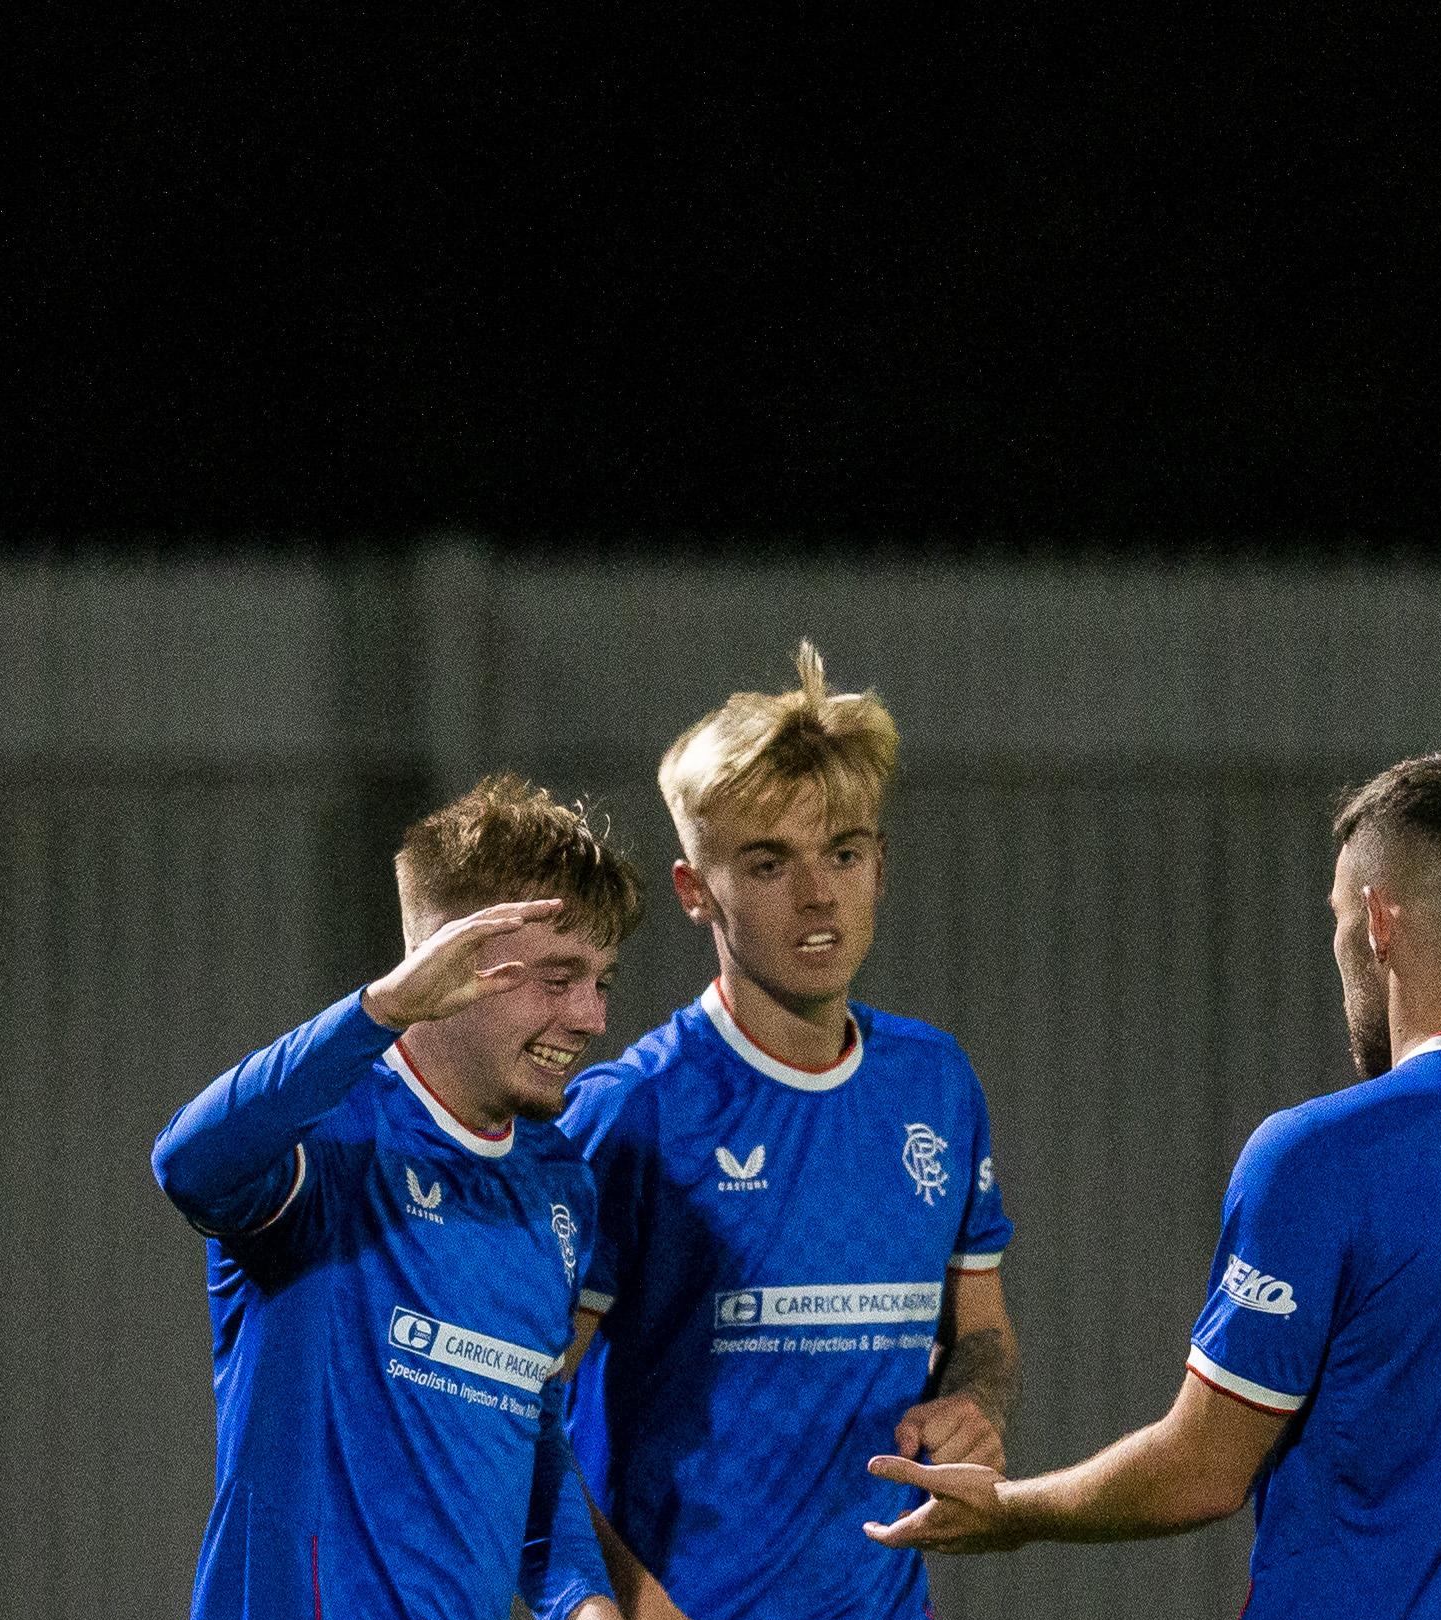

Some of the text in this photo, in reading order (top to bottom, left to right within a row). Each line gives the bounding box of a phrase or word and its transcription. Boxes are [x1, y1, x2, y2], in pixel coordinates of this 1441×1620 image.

[979, 1157, 994, 1193] S
[775, 1296, 852, 1315] CARRICK
[445, 1336, 548, 1383] CARRICK PACKAG
[783, 1338, 797, 1352] in
[799, 1336, 857, 1356] Injection
[859, 1335, 870, 1351] &
[386, 1358, 446, 1392] Specialist
[447, 1379, 458, 1396] in
[459, 1382, 498, 1409] Injection
[499, 1396, 509, 1411] &
